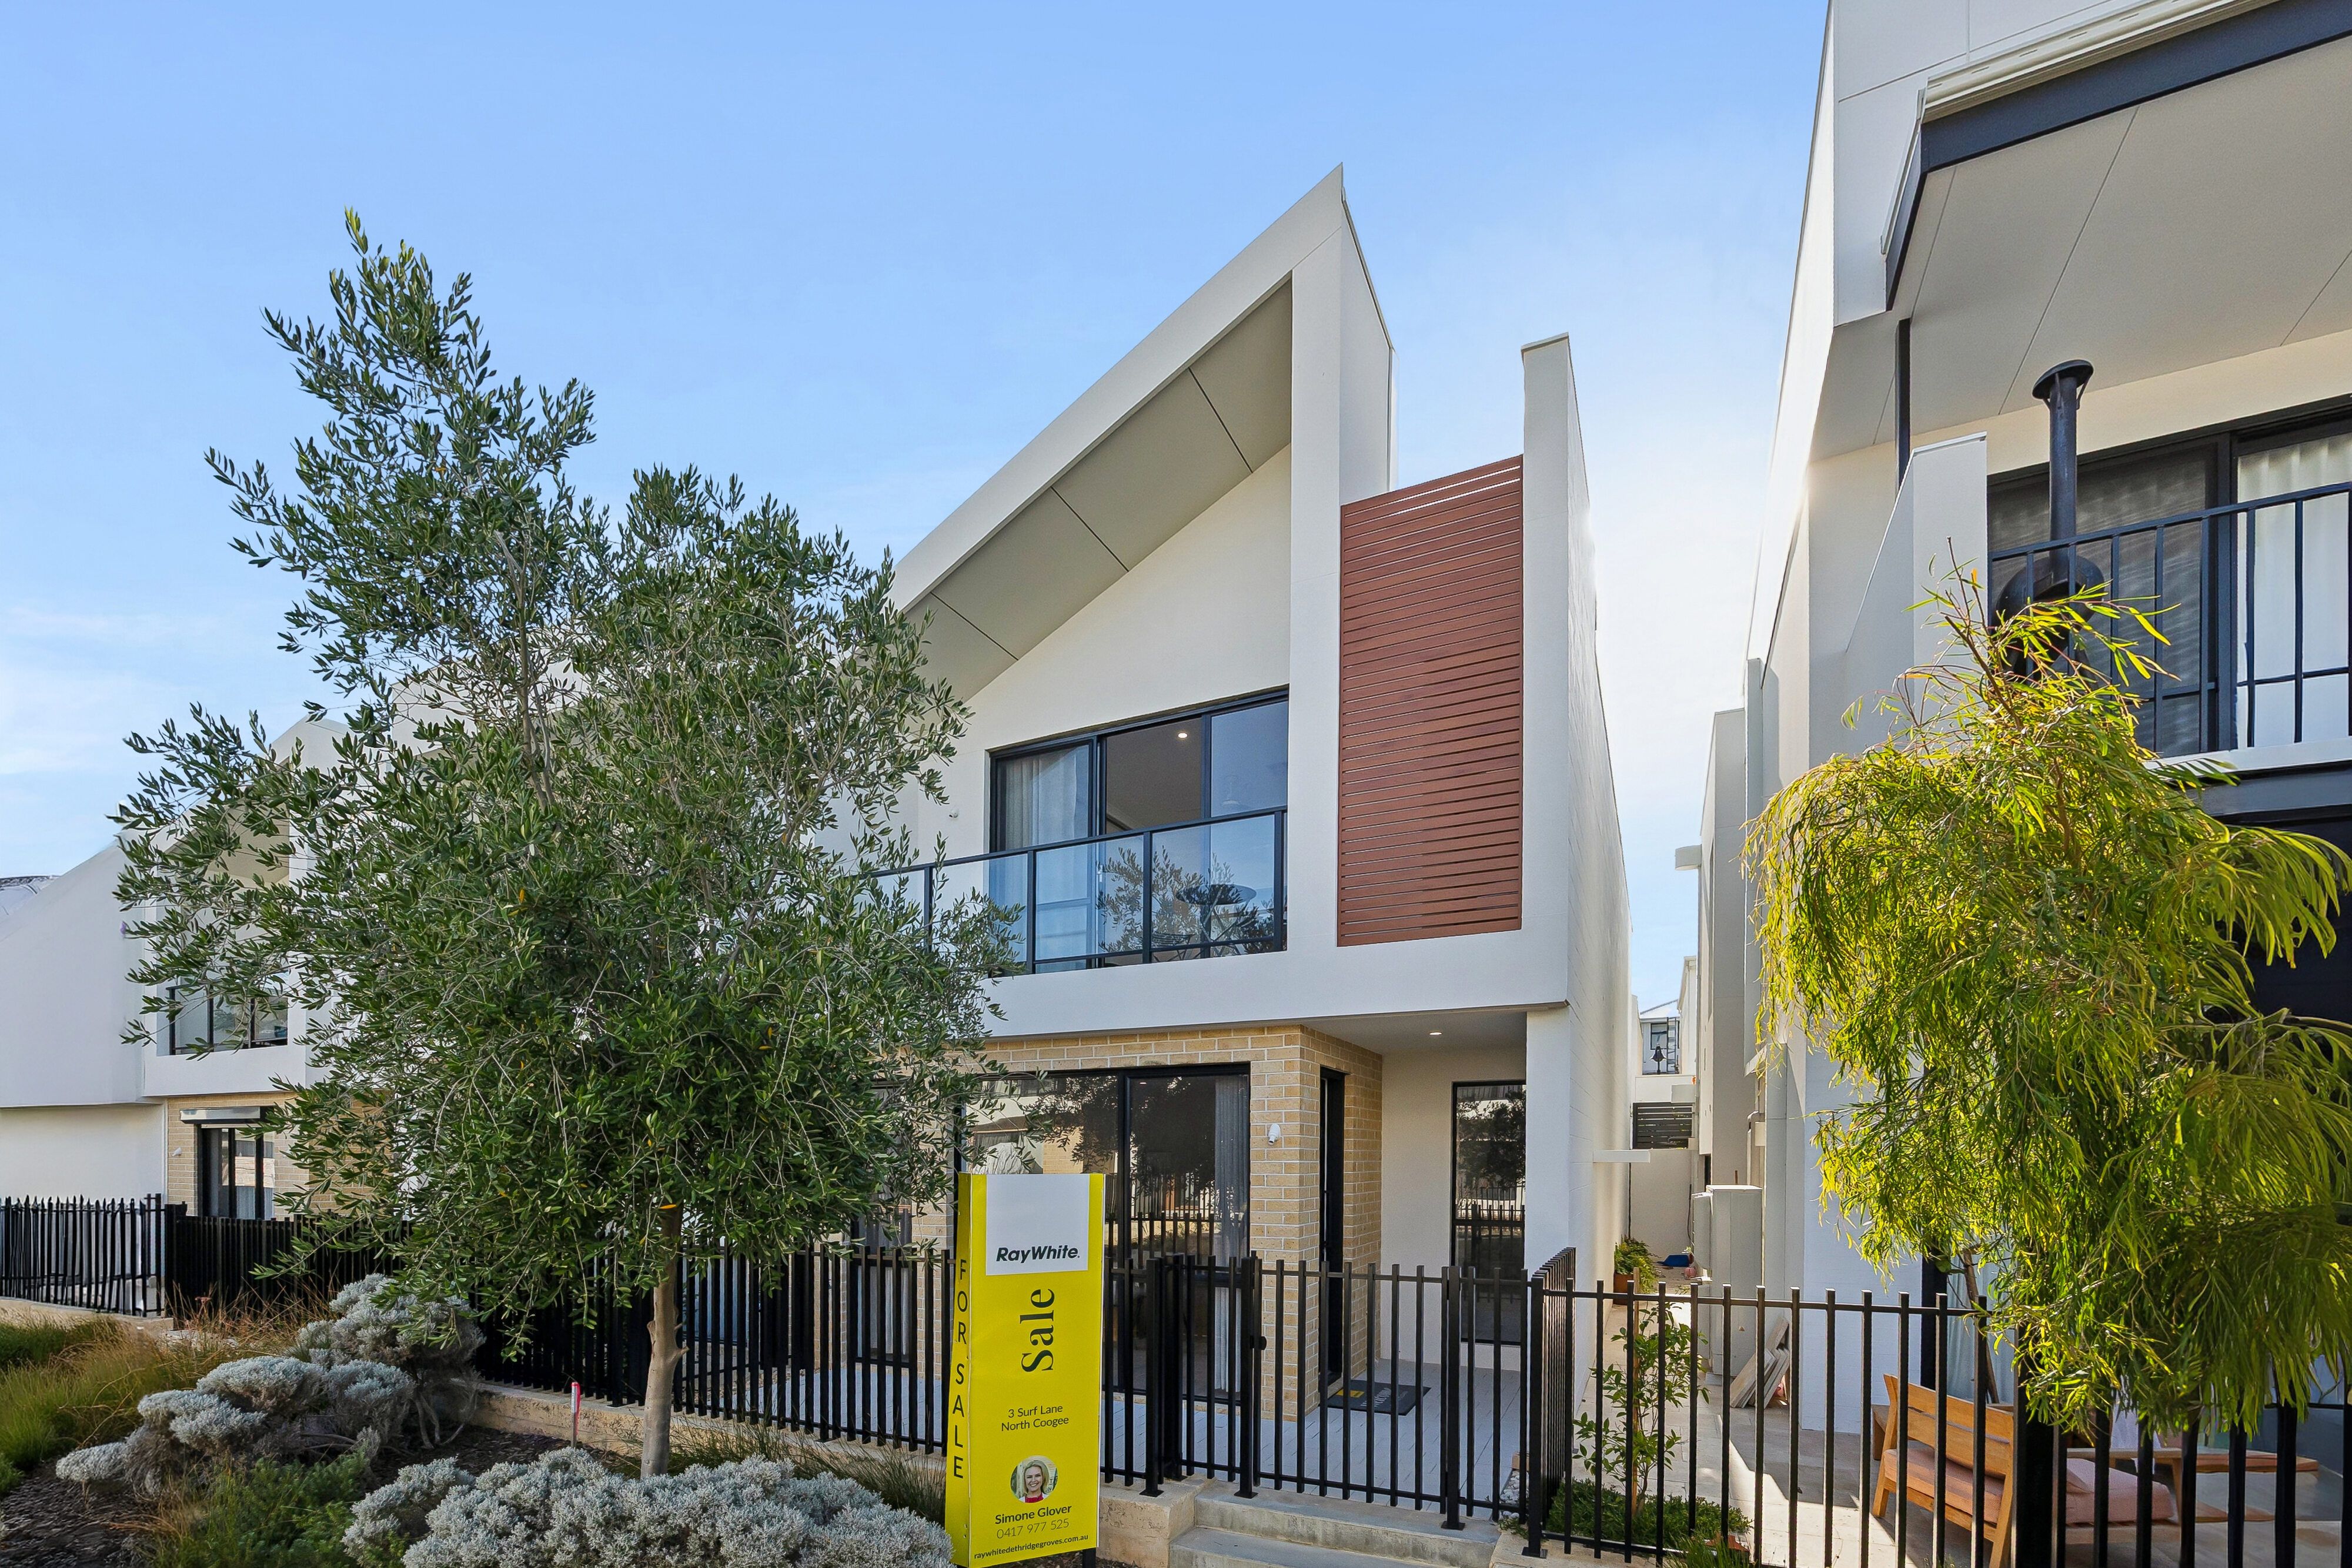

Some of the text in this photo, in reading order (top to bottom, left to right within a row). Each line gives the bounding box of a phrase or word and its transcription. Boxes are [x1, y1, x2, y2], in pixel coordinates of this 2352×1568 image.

[1020, 1288, 1055, 1372] Sale
[952, 1259, 968, 1479] FOR SALE
[1008, 1405, 1063, 1418] 3 Surf Lane
[1001, 1417, 1069, 1432] North Coogee
[995, 1505, 1072, 1524] Simone Glover
[996, 1518, 1070, 1539] 0417 977 525
[974, 1534, 1089, 1559] raywhitedethridgegroves.com.au
